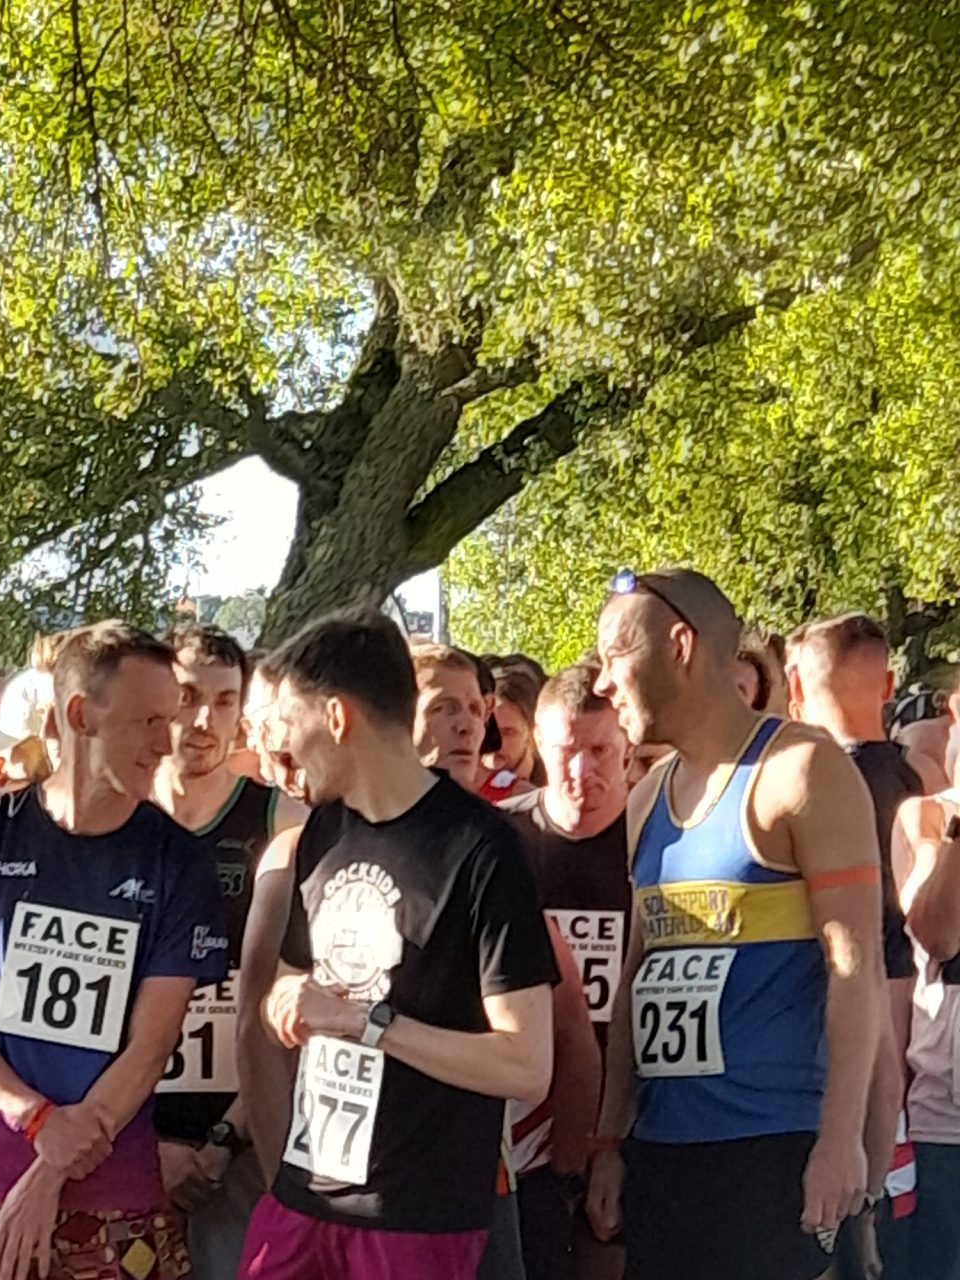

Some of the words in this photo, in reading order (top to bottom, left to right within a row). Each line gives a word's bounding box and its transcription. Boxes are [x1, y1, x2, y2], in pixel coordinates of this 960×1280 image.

[20, 911, 129, 956] F.A.C.E
[16, 961, 112, 1036] 181
[641, 954, 726, 982] F.A.C.E
[640, 1000, 708, 1064] 231
[293, 1089, 370, 1167] 277
